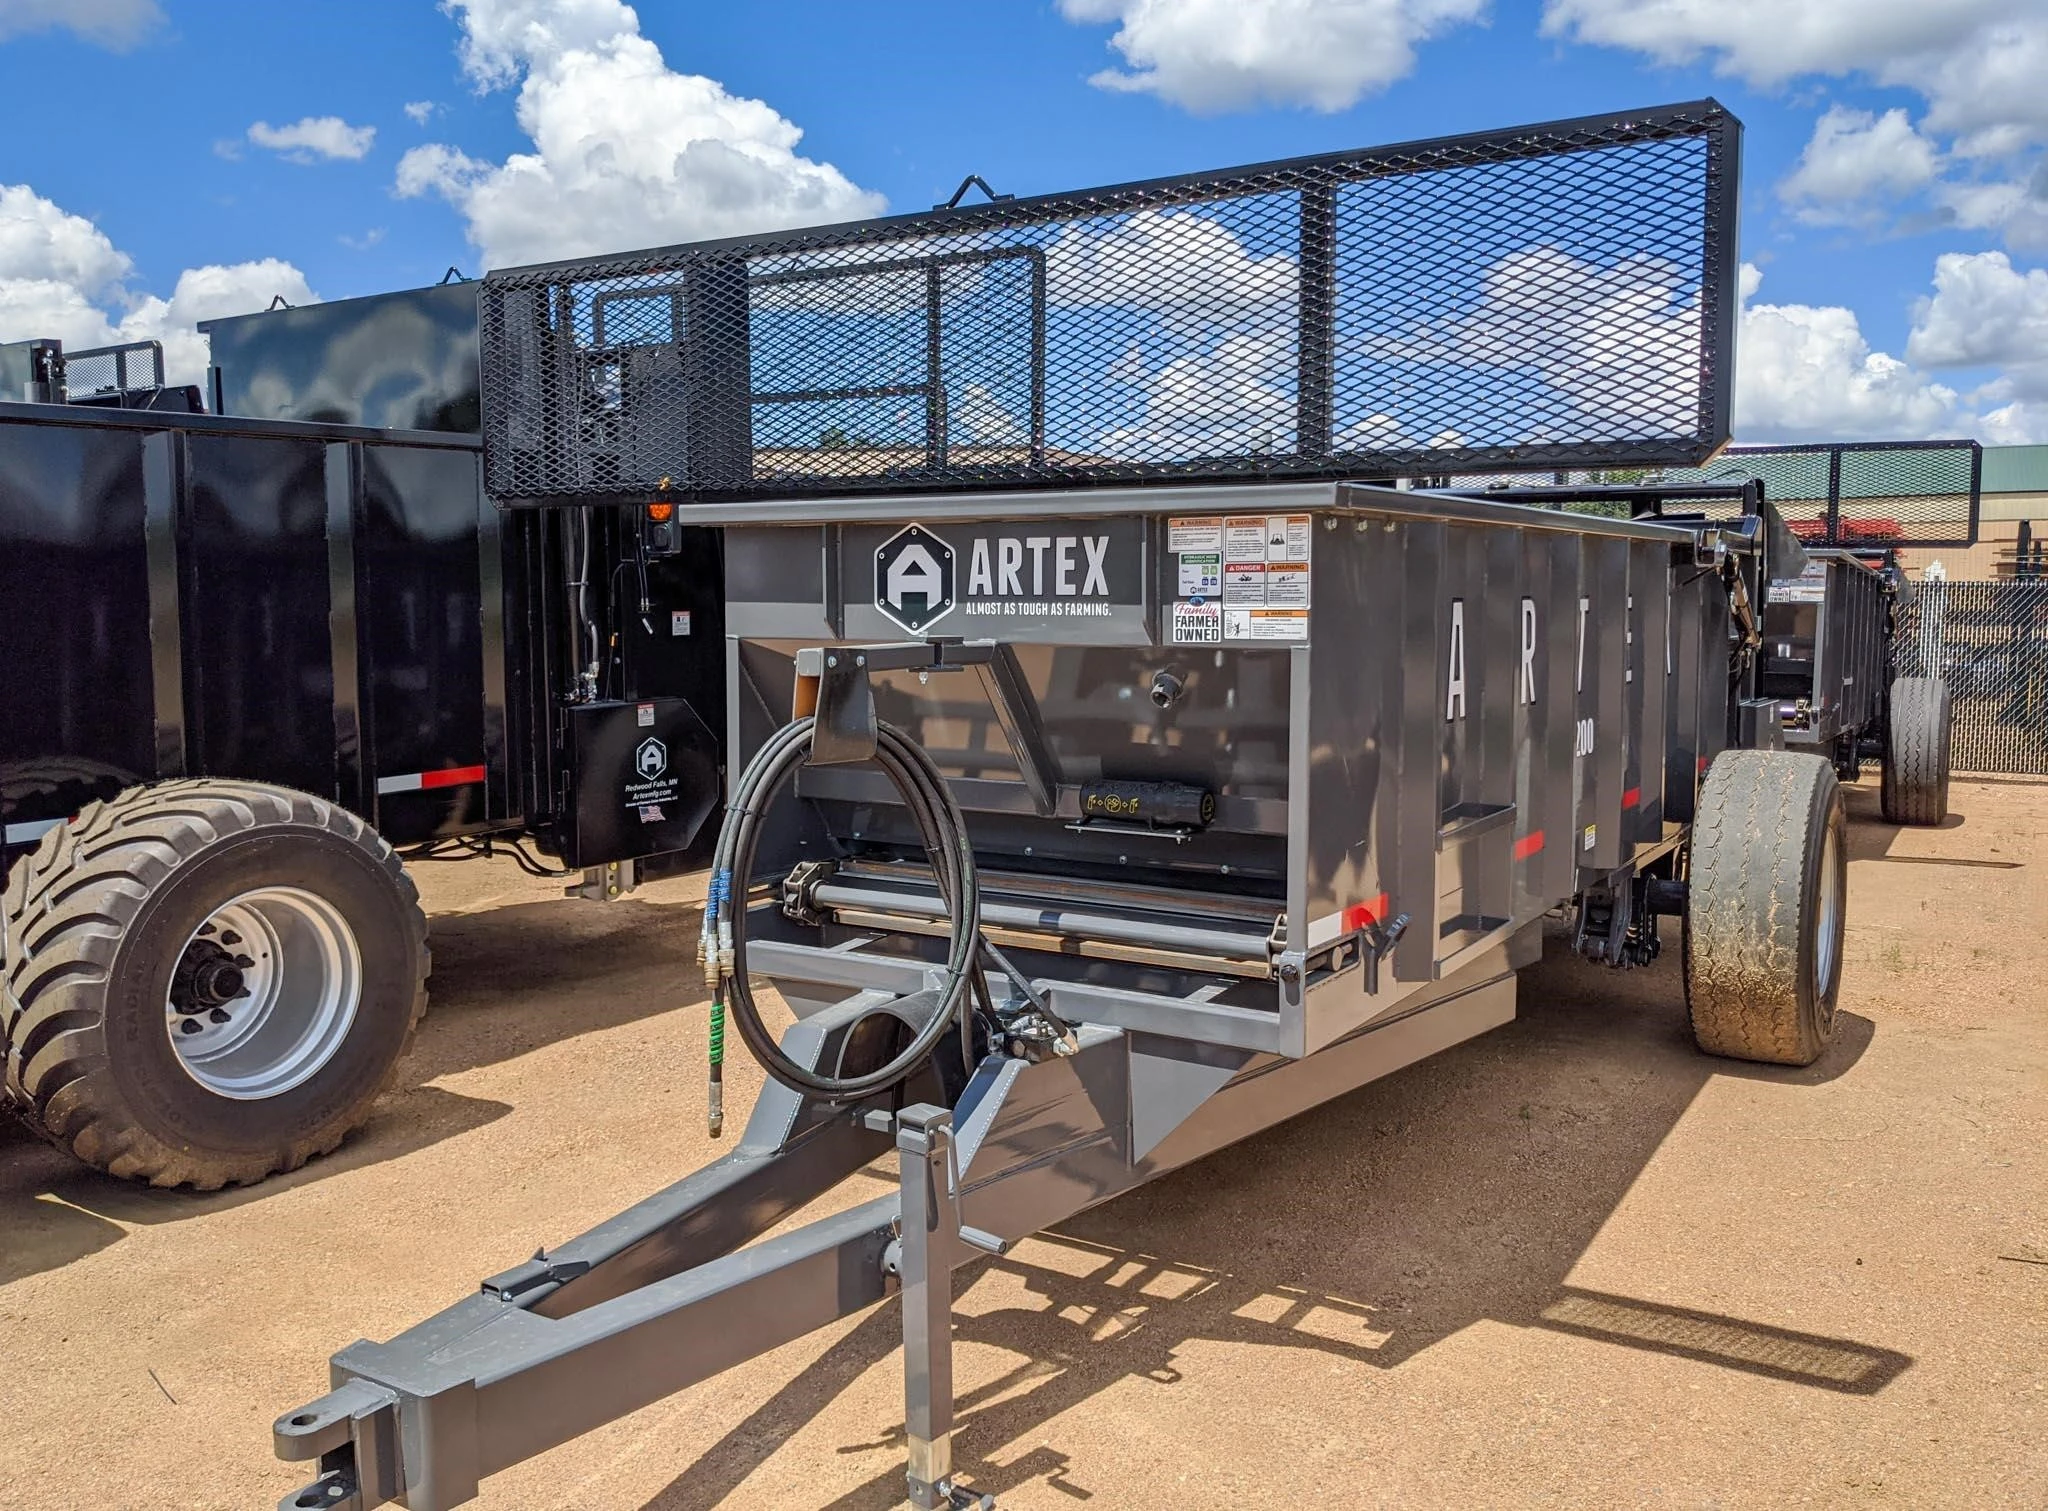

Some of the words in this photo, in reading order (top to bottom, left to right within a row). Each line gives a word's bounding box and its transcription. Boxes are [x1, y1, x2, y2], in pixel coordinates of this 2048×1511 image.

[967, 536, 1110, 596] ARTEX
[966, 602, 1001, 615] ALMOST
[1004, 602, 1016, 615] AS
[1018, 602, 1048, 615] TOUGH
[1050, 602, 1063, 616] AS
[1065, 603, 1112, 616] FARMING.
[1175, 602, 1217, 618] Family
[1175, 615, 1219, 628] FARMER
[1175, 628, 1219, 641] OWNED
[625, 782, 652, 793] Redwood
[652, 780, 667, 788] Falls,
[668, 778, 679, 786] MN
